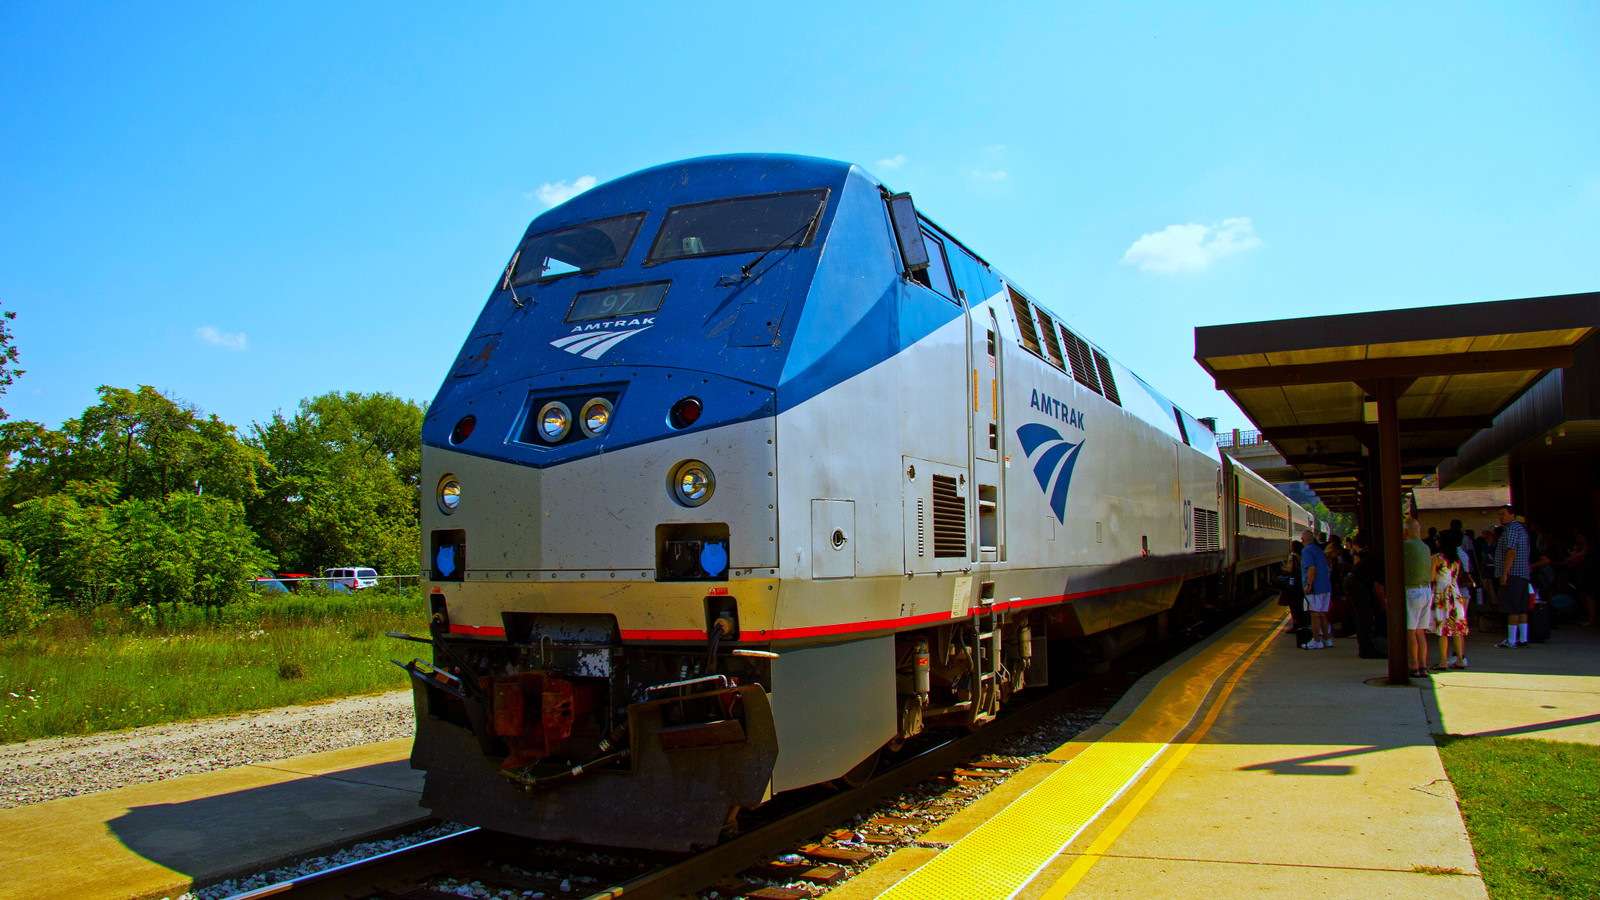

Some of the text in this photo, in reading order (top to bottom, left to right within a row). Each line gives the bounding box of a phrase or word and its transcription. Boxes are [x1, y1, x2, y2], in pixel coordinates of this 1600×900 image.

[600, 292, 636, 314] 97
[570, 317, 656, 333] AMTRAK
[1030, 388, 1085, 431] AMTRAK
[1183, 500, 1191, 548] 97
